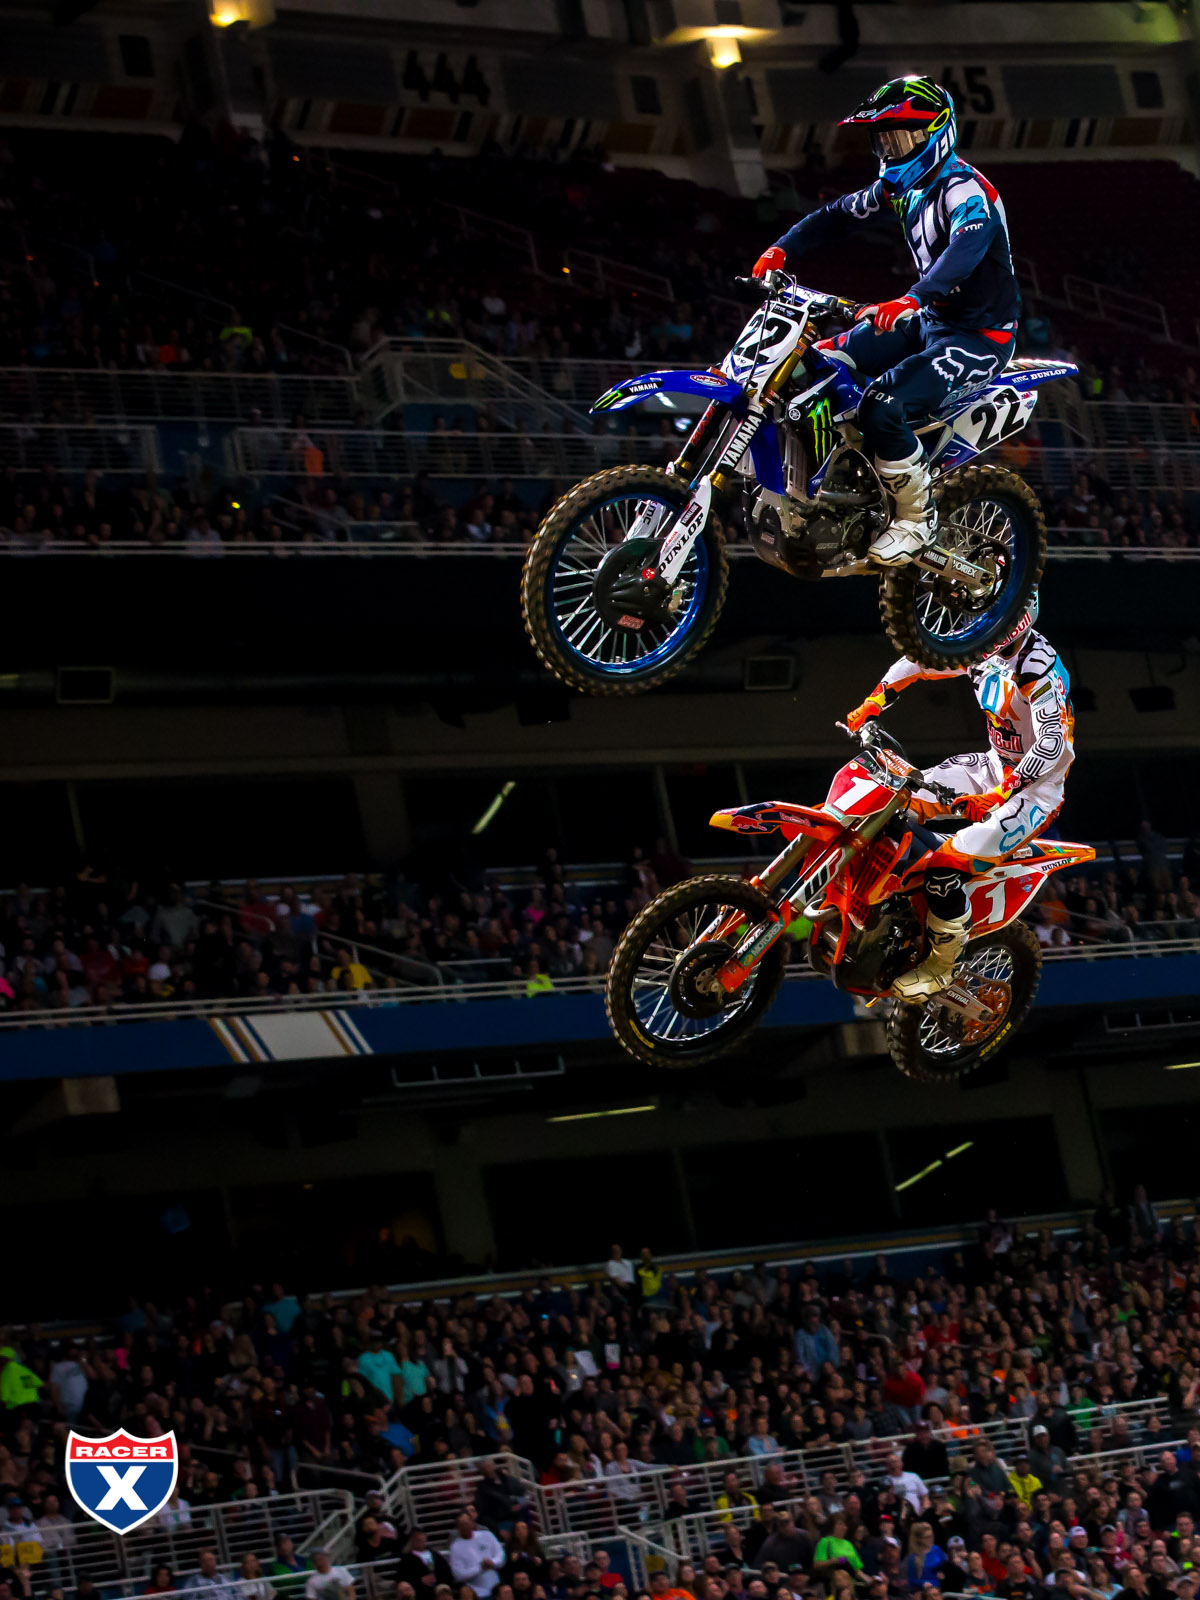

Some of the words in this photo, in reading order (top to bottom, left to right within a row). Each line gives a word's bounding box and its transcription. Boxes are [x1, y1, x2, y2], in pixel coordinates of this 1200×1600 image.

[404, 50, 490, 105] 444
[943, 67, 994, 114] 45
[951, 195, 987, 223] 22
[732, 314, 792, 364] 22
[629, 382, 659, 394] YAMAHA
[1031, 368, 1067, 380] DUNLOP
[867, 389, 895, 404] FOX
[970, 387, 1025, 452] 22
[721, 412, 763, 468] YAMAHA
[659, 512, 704, 574] DUNLOP
[832, 776, 880, 812] 1
[1041, 857, 1073, 872] DUNLOP
[985, 880, 1006, 924] 1
[751, 921, 784, 957] MOTOREX
[946, 989, 971, 1006] ENTHAL
